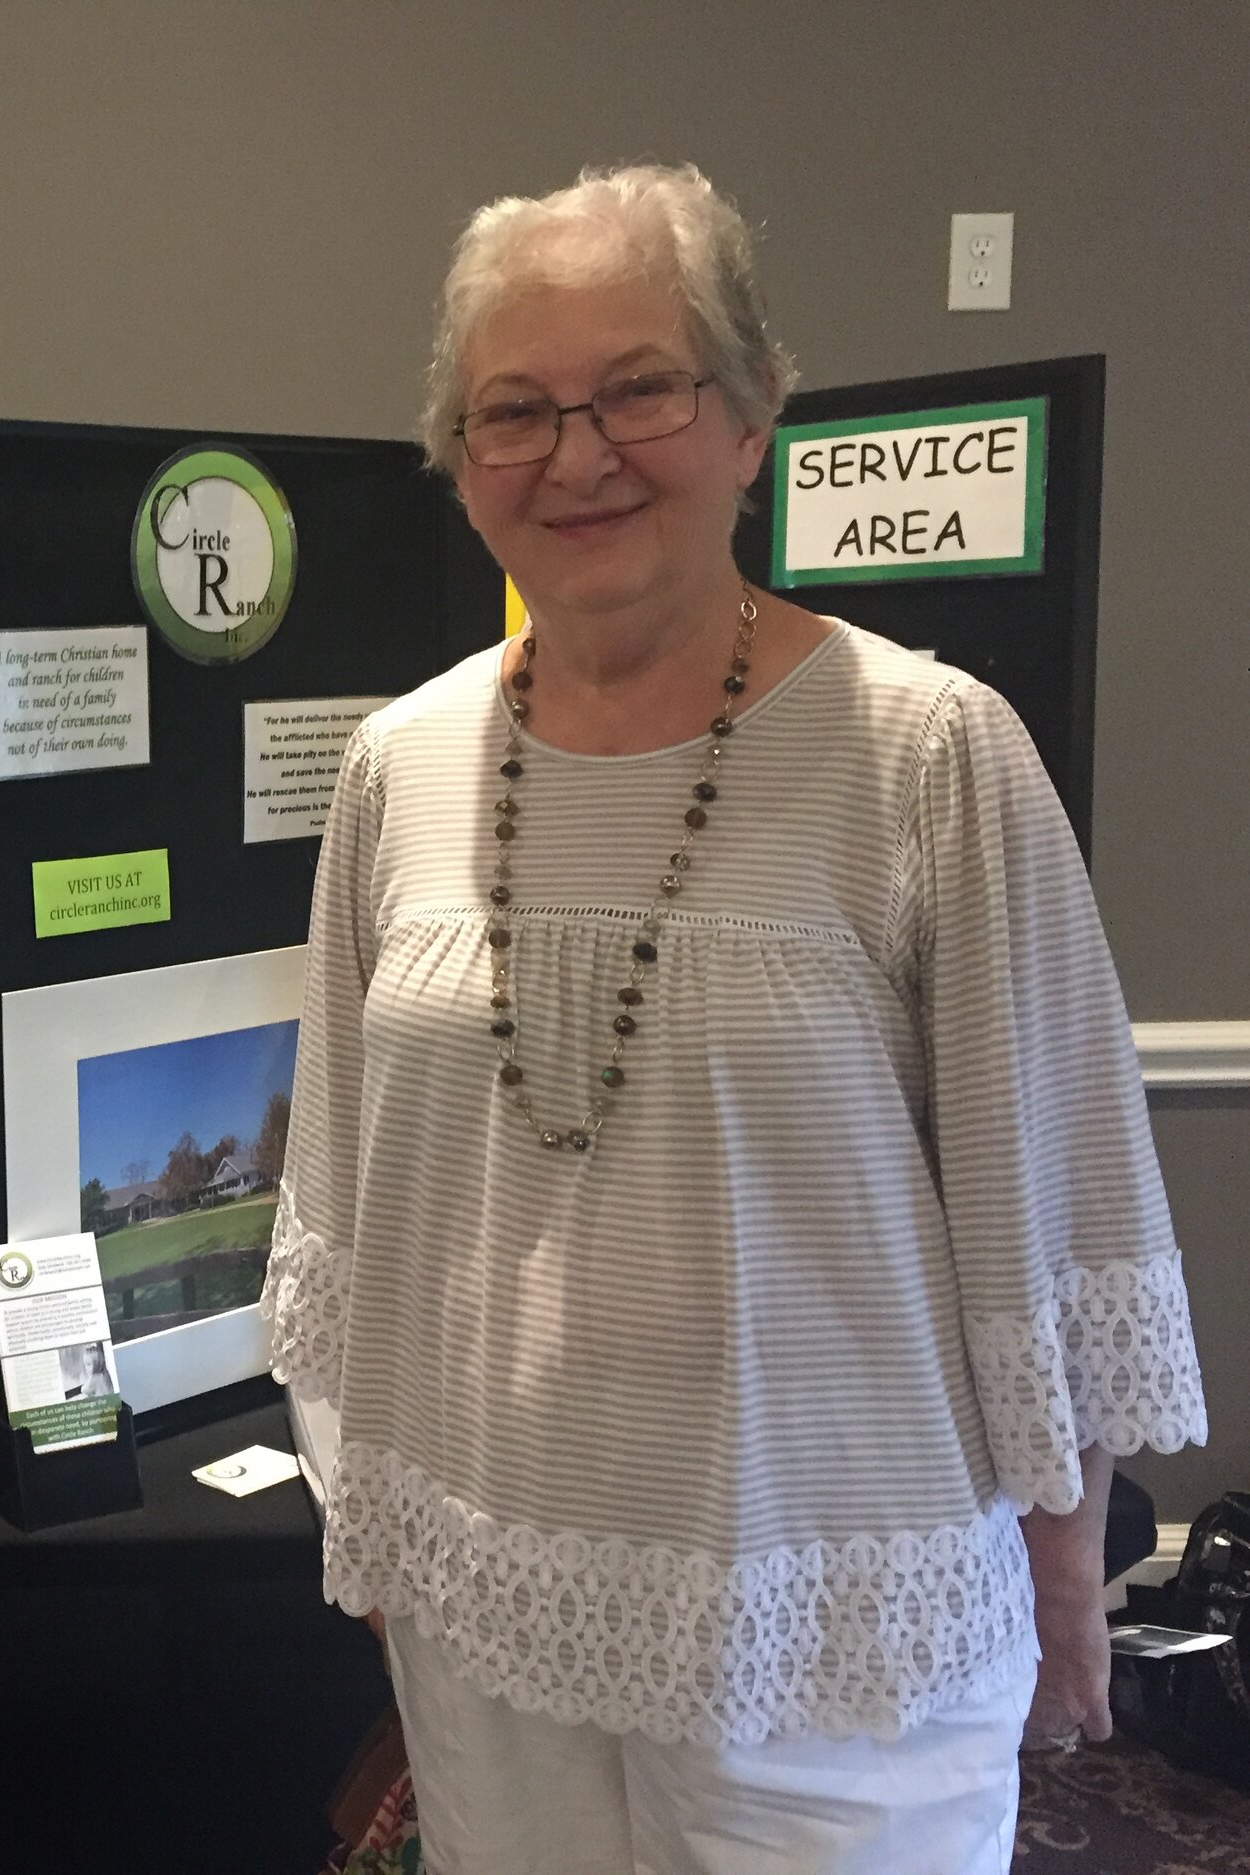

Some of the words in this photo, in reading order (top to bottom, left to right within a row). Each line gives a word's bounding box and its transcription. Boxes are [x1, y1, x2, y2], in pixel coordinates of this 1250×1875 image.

[796, 427, 1018, 489] SERVICE
[150, 484, 231, 550] Circle
[834, 510, 966, 558] AREA
[194, 553, 276, 616] Ranch
[6, 648, 57, 669] long-term
[60, 646, 109, 664] Christian
[111, 643, 138, 659] home
[8, 671, 29, 688] and
[32, 668, 62, 686] ranch
[62, 668, 81, 689] for
[83, 666, 124, 683] children
[18, 696, 29, 709] in
[32, 692, 56, 708] need
[59, 691, 73, 711] of
[74, 696, 81, 706] a
[81, 689, 117, 710] family
[3, 718, 43, 734] because
[46, 714, 60, 735] of
[61, 712, 132, 729] circumstances
[280, 715, 290, 725] he
[290, 715, 304, 724] will
[304, 713, 329, 724] deliver
[330, 713, 342, 722] the
[8, 742, 25, 756] not
[28, 738, 43, 759] of
[44, 736, 69, 753] their
[71, 738, 95, 750] own
[97, 732, 128, 751] doing.
[270, 734, 282, 743] the
[283, 731, 315, 743] afflicted
[315, 731, 330, 741] who
[331, 730, 348, 740] have
[260, 752, 270, 761] He
[271, 751, 285, 760] will
[286, 750, 302, 760] take
[303, 749, 317, 761] pity
[318, 750, 327, 758] on
[328, 748, 340, 757] the
[281, 768, 295, 778] and
[296, 768, 313, 777] save
[314, 767, 326, 777] the
[247, 789, 256, 799] He
[258, 788, 272, 797] will
[273, 787, 297, 797] rescue
[299, 786, 317, 795] them
[267, 806, 279, 815] for
[280, 804, 311, 815] precious
[312, 803, 319, 811] is
[68, 877, 102, 894] VISIT
[106, 874, 122, 890] US
[125, 871, 143, 887] AT
[50, 894, 162, 921] circleranchinc.org
